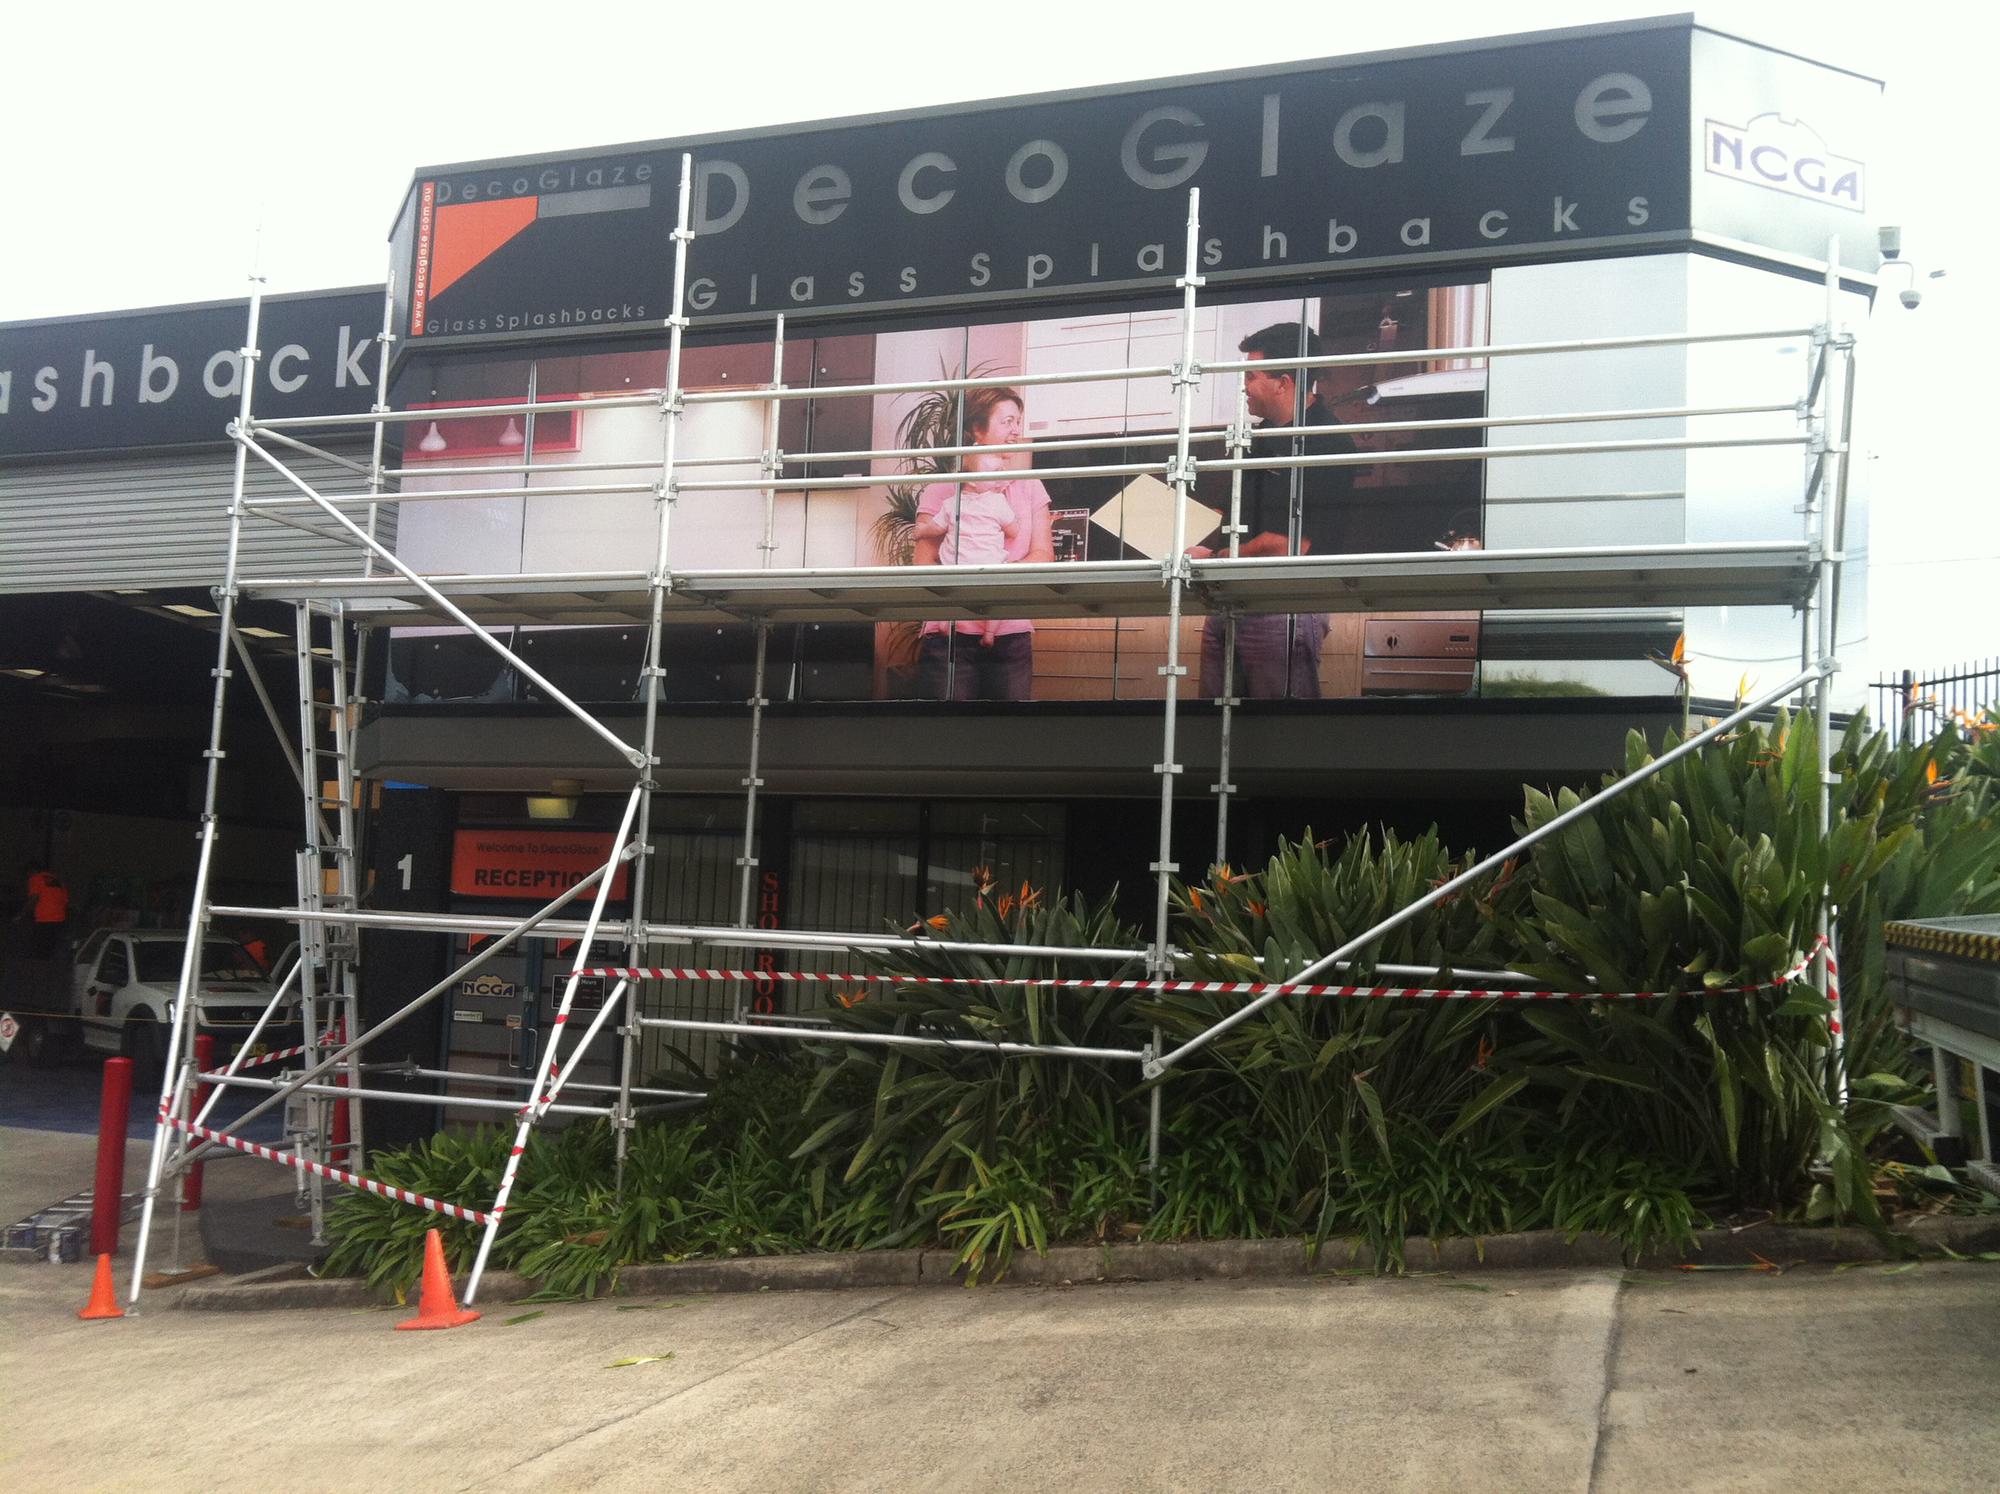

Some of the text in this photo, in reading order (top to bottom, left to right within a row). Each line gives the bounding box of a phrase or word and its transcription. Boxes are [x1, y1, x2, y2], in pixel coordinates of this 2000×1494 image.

[695, 71, 1653, 236] DecoGlaze
[1712, 130, 1857, 202] NCGA
[436, 164, 652, 203] DecoGlaze
[414, 186, 432, 329] www.decoglaze.com.au
[687, 195, 1650, 310] Glass Splashbacks
[426, 303, 646, 335] Glass Splashbacks
[398, 854, 413, 890] 1
[474, 868, 603, 889] RECEPTIO
[463, 982, 513, 997] NCGA
